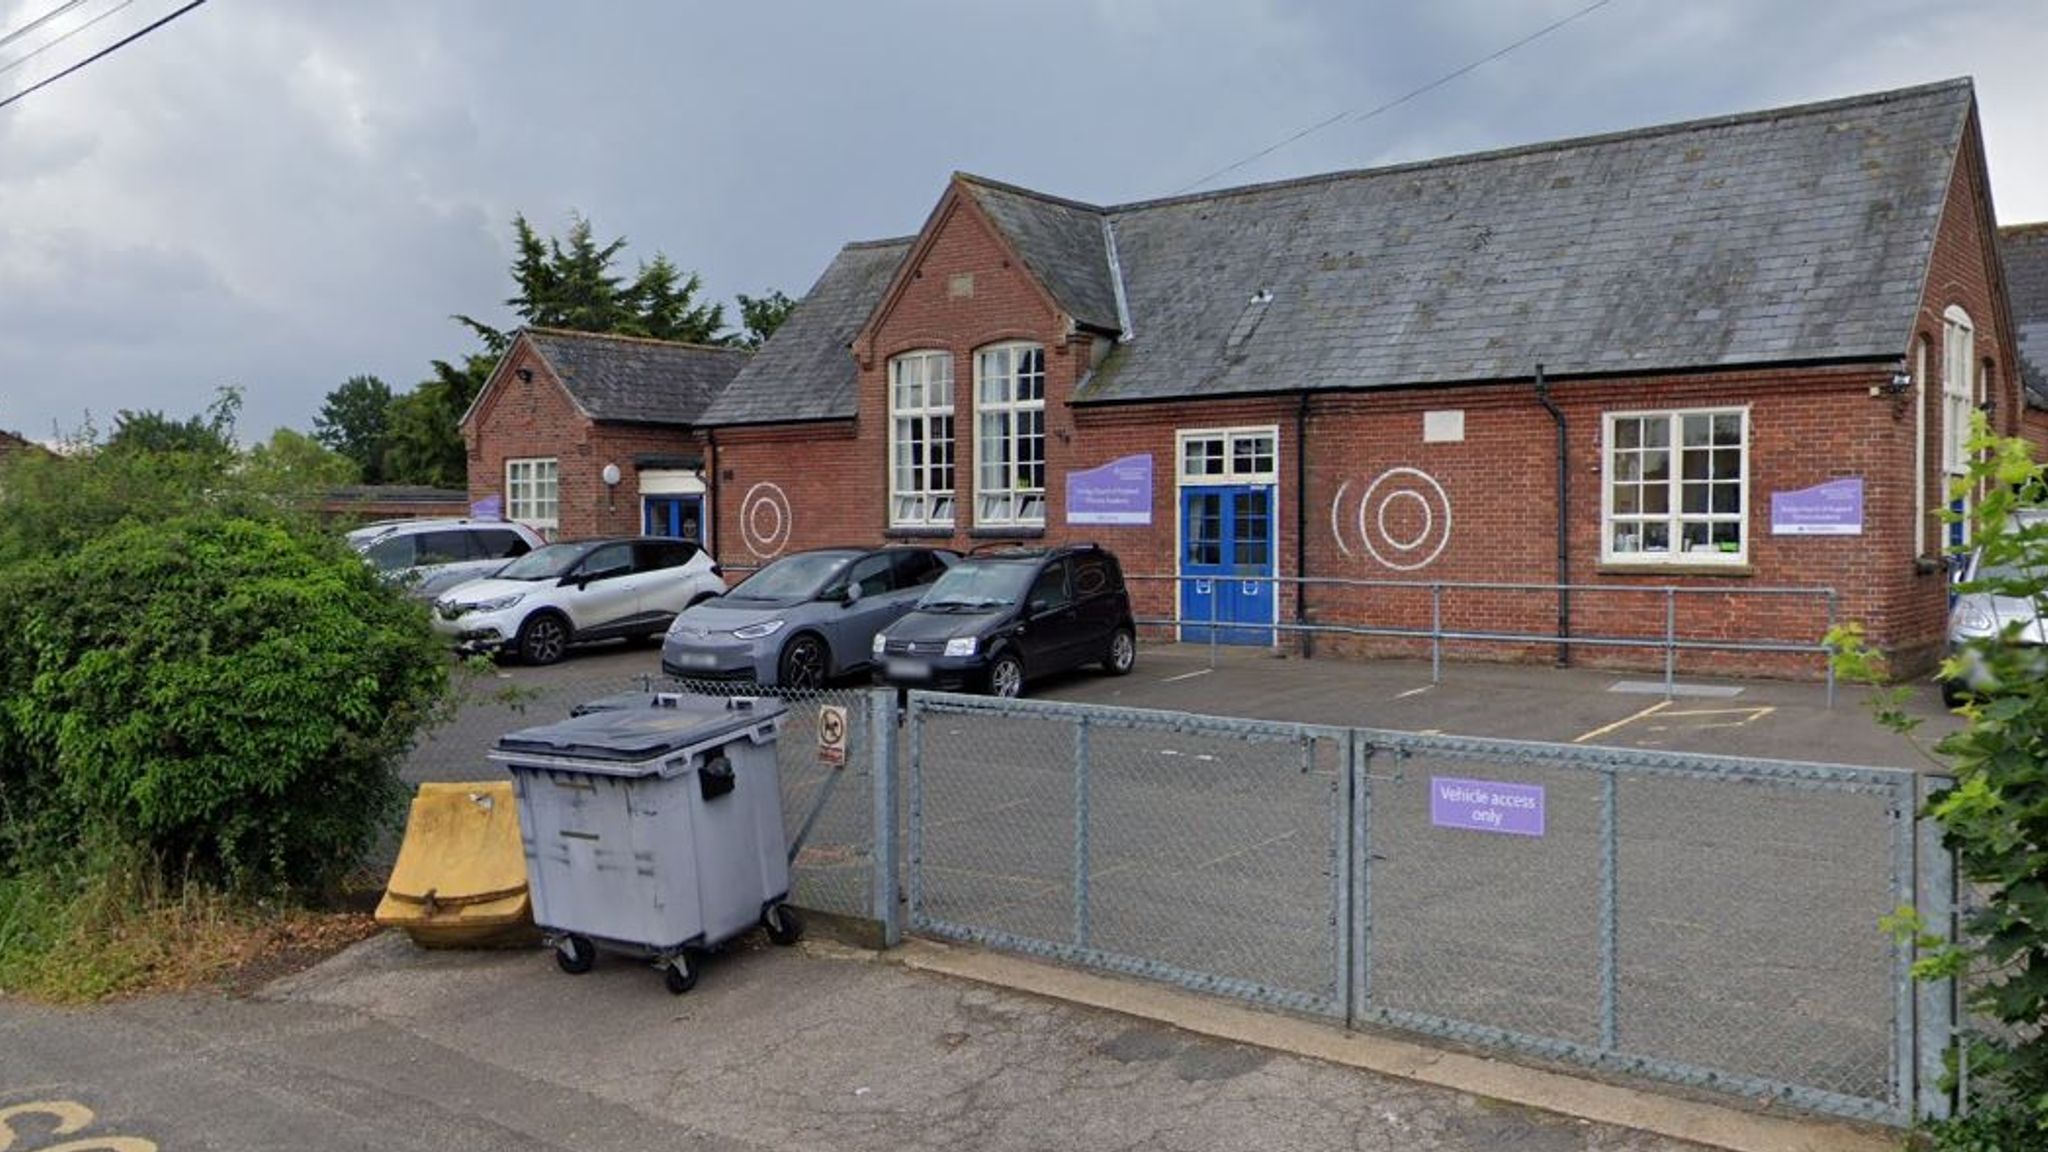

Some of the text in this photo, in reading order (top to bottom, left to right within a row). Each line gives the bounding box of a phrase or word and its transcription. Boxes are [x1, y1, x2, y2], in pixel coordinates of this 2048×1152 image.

[1440, 783, 1536, 809] Vehicle access
[1471, 808, 1503, 826] only
